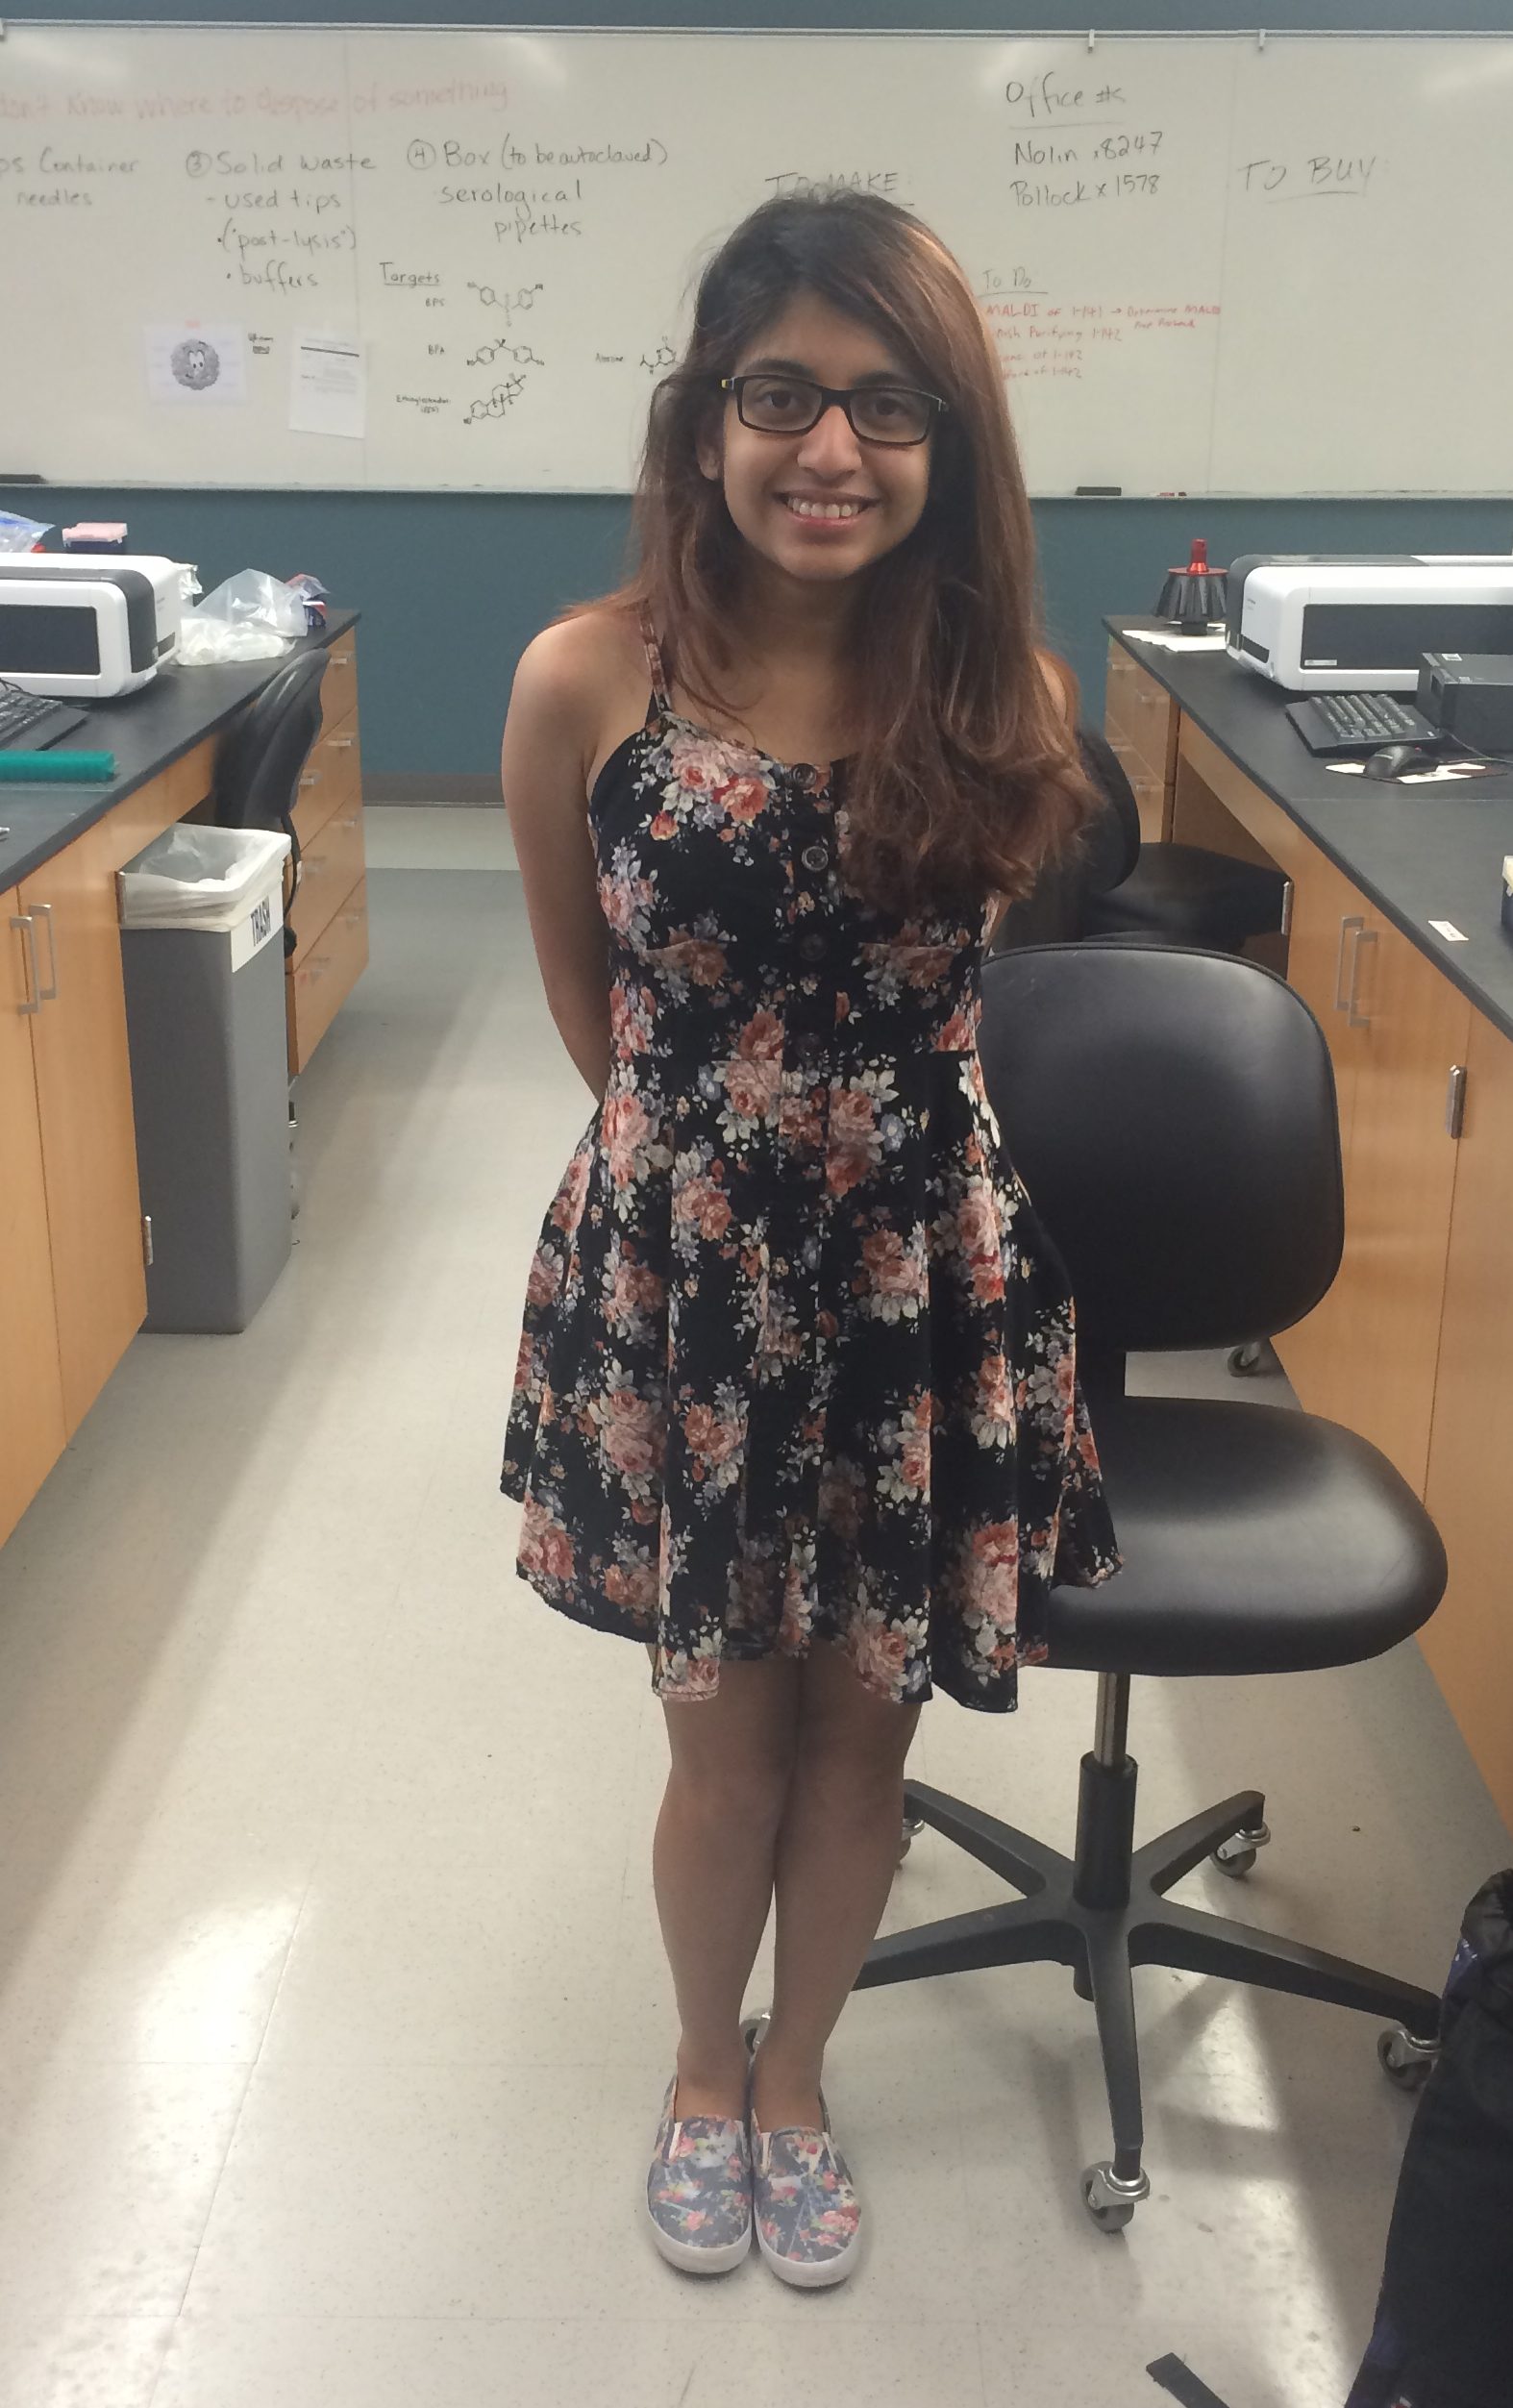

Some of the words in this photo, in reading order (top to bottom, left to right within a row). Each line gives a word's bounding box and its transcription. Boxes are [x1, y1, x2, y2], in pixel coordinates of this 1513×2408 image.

[1005, 71, 1084, 117] Office
[39, 145, 140, 174] Container
[216, 150, 284, 176] Solid
[443, 139, 491, 167] Box
[1014, 140, 1078, 165] Nolin
[1236, 158, 1288, 192] TO
[1307, 155, 1377, 190] BUY
[16, 187, 93, 207] needles
[224, 189, 279, 210] used
[290, 188, 341, 215] tips
[438, 178, 583, 222] serological
[1009, 180, 1091, 208] Pollock
[493, 213, 583, 244] pipettes
[239, 259, 319, 295] buffers
[378, 261, 441, 288] Targets
[981, 268, 1002, 290] To
[1012, 265, 1032, 288] Do
[986, 302, 1039, 317] MALDI
[250, 894, 272, 948] TRASH
